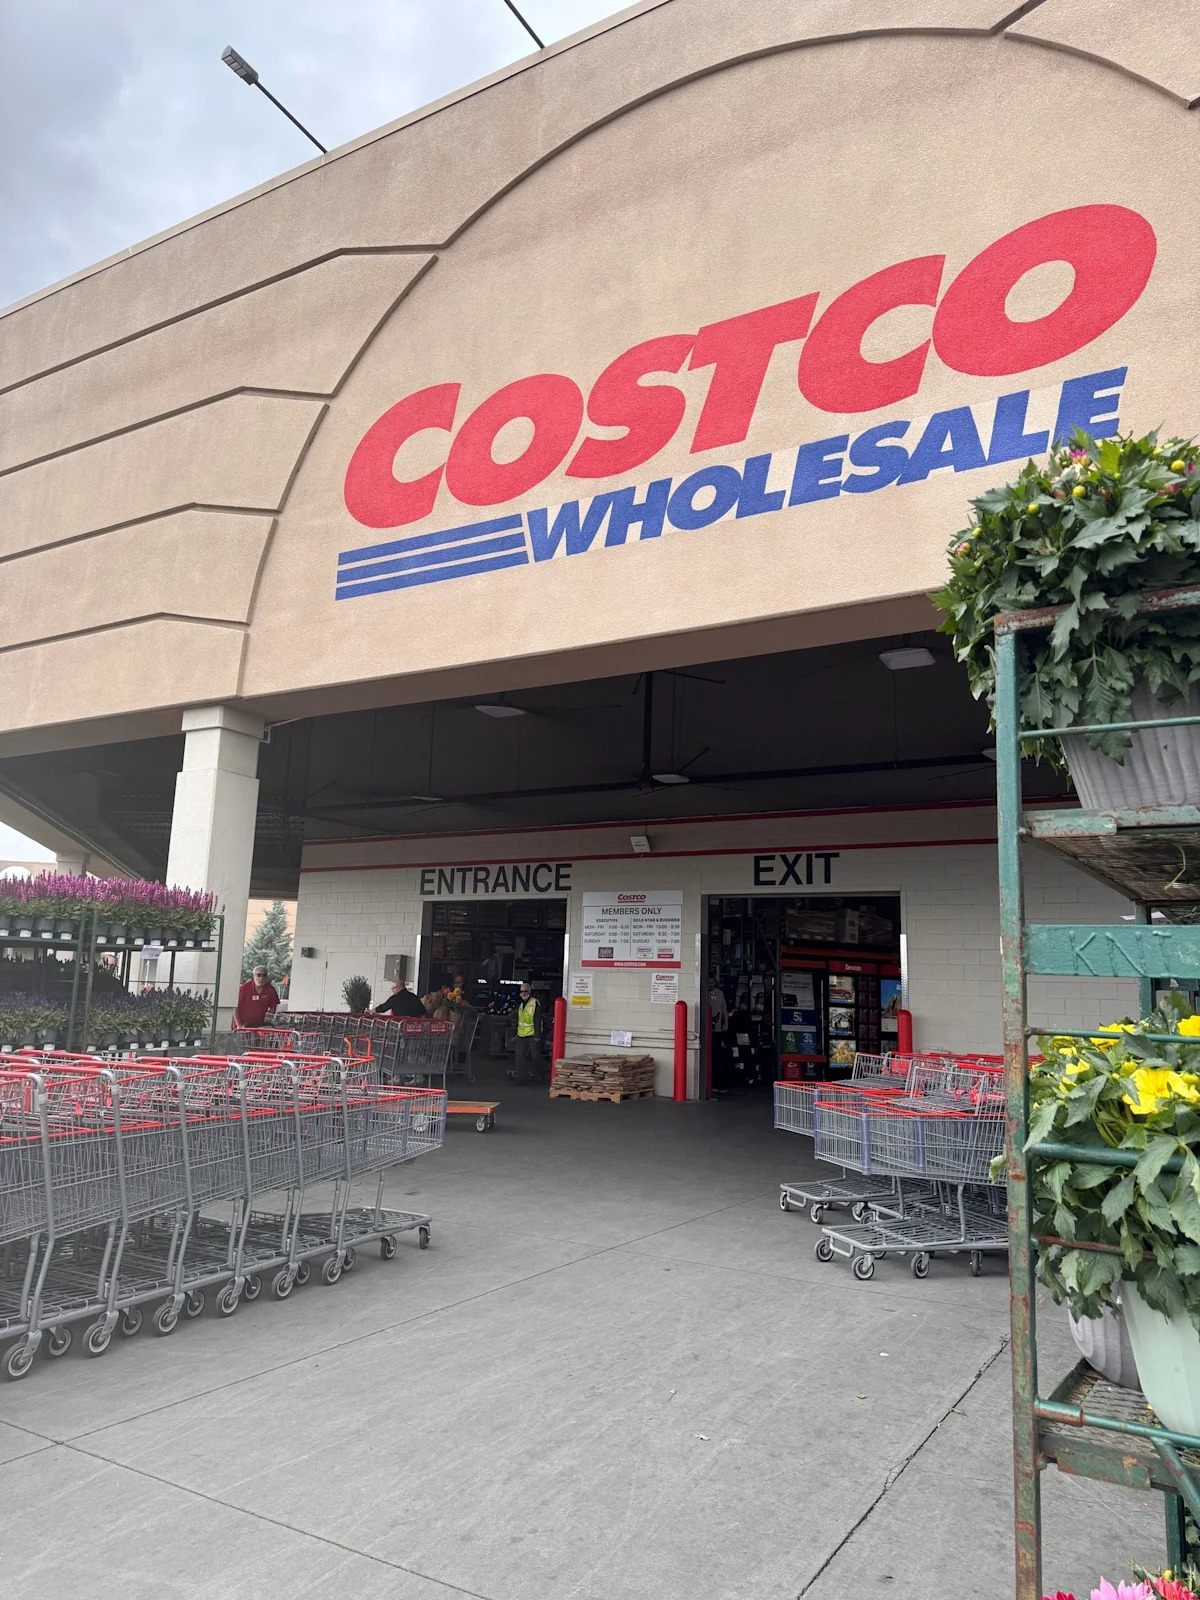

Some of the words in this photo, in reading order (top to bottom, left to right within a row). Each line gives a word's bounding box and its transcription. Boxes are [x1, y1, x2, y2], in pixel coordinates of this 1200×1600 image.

[344, 205, 1157, 529] COSTCO
[525, 367, 1128, 565] WHOLESALE
[420, 863, 573, 896] ENTRANCE
[754, 852, 840, 886] EXIT
[601, 907, 640, 915] MEMBERS
[641, 907, 662, 915] ONLY
